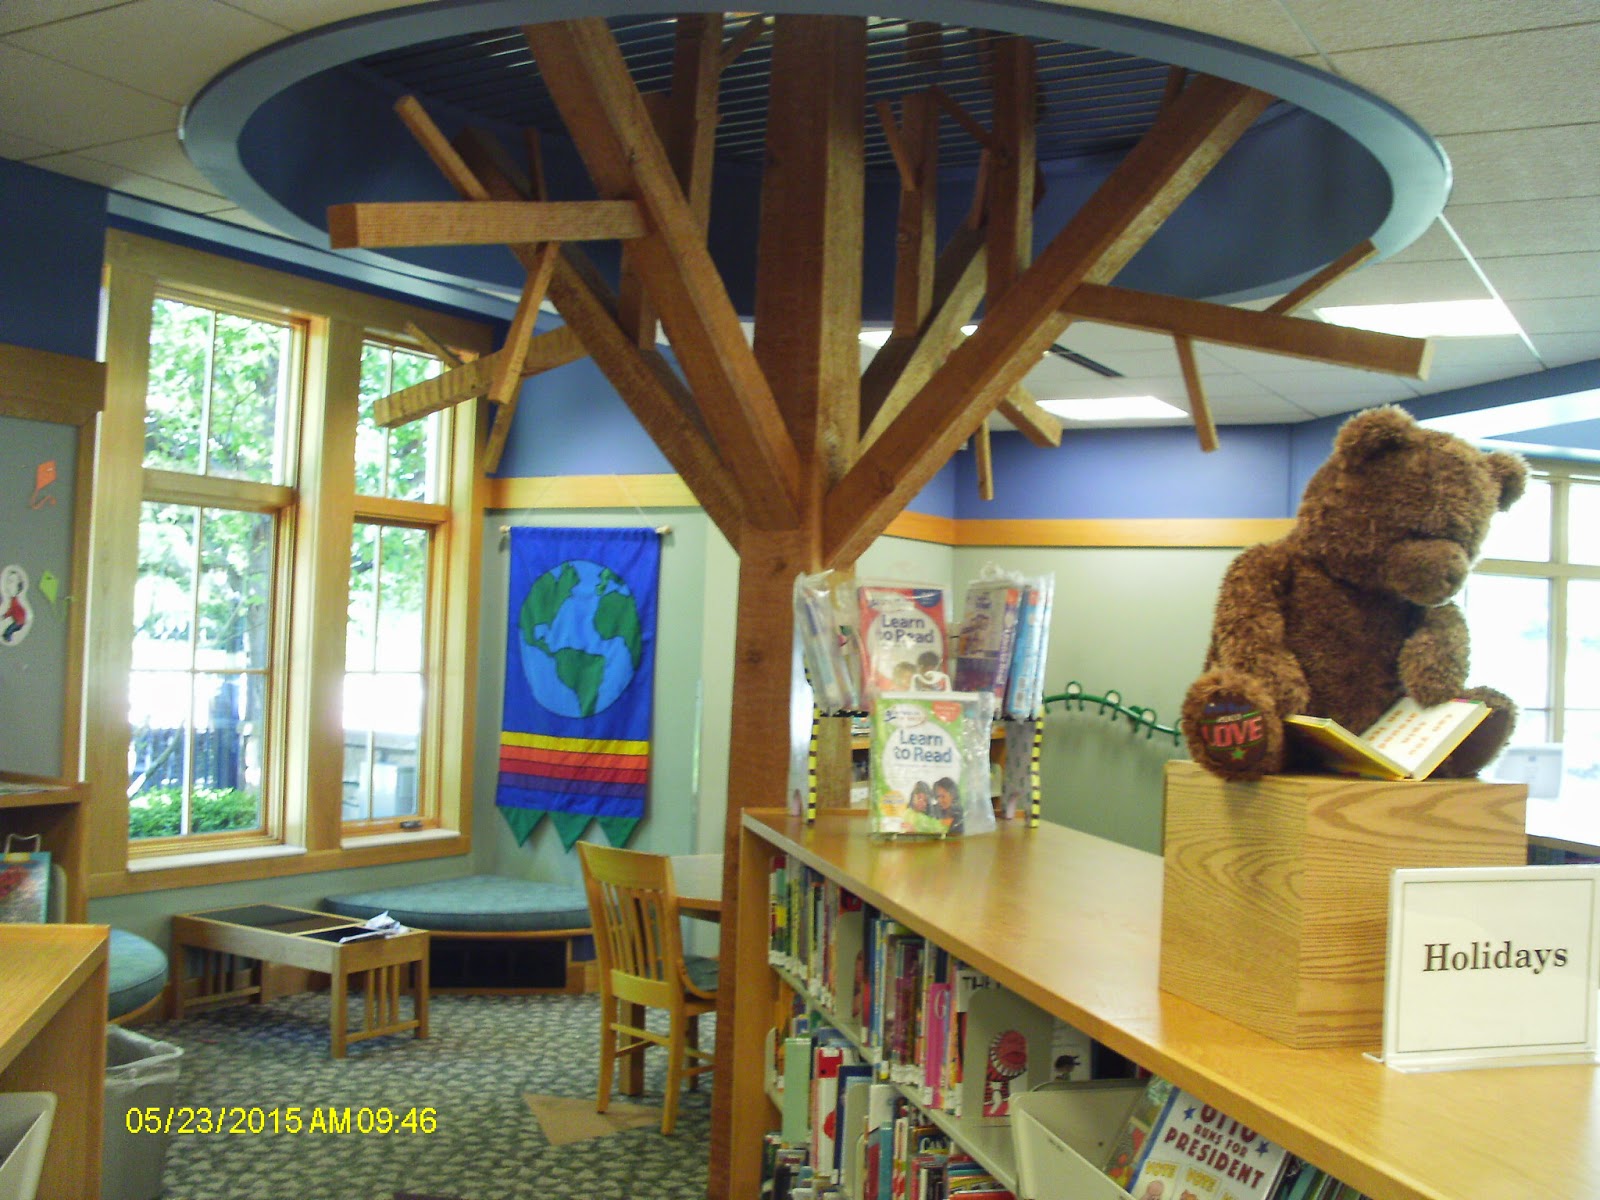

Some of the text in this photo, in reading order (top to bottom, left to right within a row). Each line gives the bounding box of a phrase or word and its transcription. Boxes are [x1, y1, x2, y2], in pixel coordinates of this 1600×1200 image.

[882, 614, 925, 629] Learn
[900, 729, 943, 746] Learn
[1202, 716, 1263, 747] LOVE
[894, 746, 952, 763] to Read
[1423, 941, 1568, 974] Holidays
[1193, 1124, 1249, 1158] RUNS FOR
[1164, 1126, 1265, 1189] PRESIDENT
